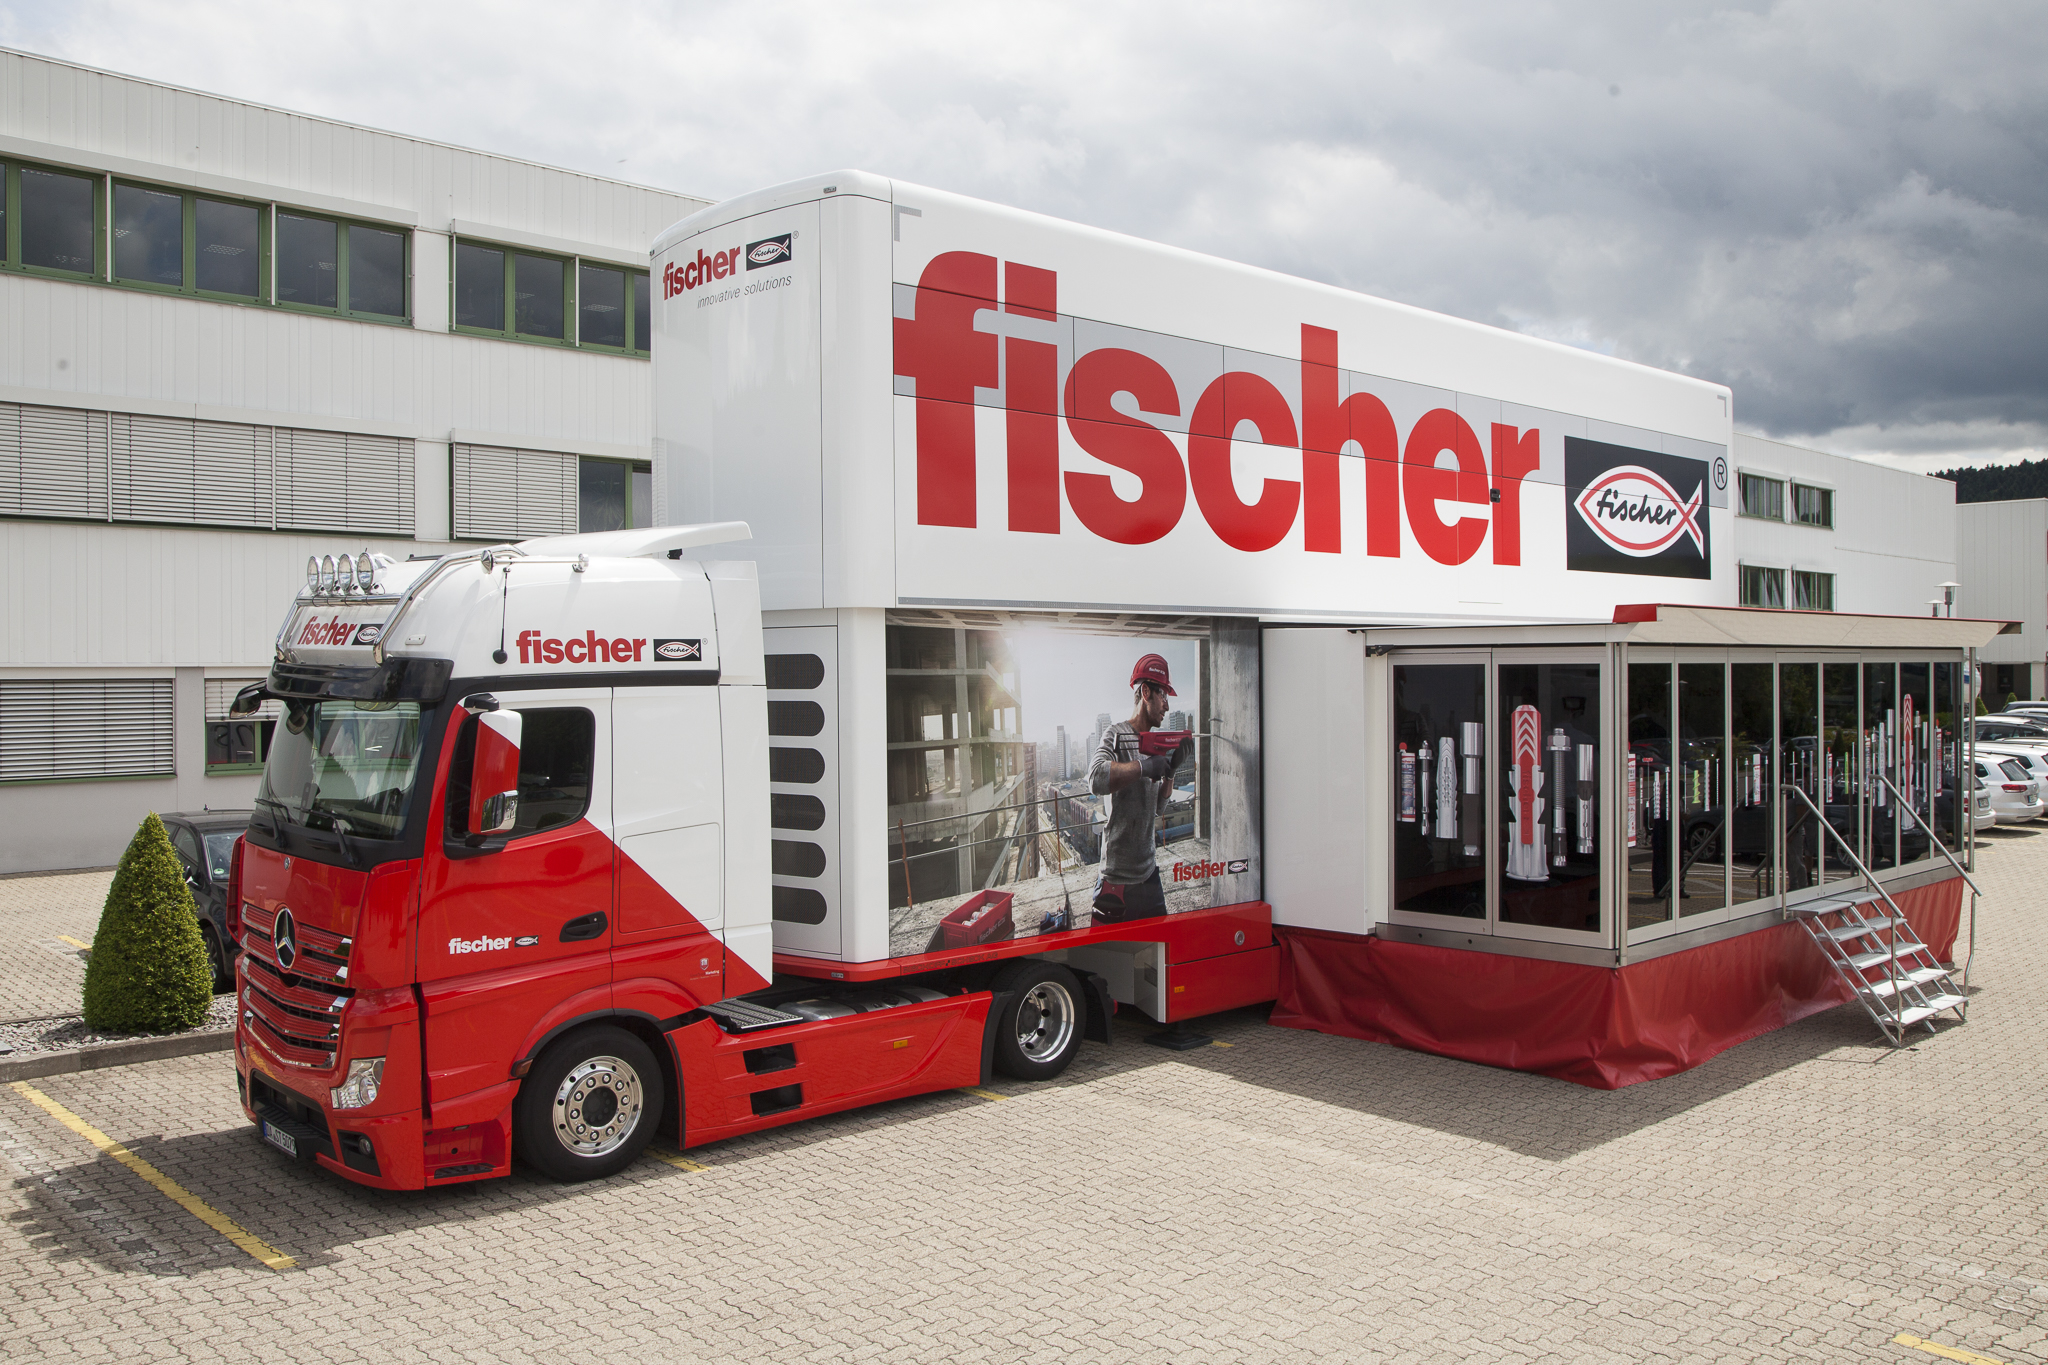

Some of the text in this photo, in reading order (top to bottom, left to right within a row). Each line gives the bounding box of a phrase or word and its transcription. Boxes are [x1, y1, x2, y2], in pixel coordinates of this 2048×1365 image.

[662, 245, 741, 301] fischer
[697, 275, 792, 309] innovative solutions
[893, 250, 1540, 566] fischer
[1596, 488, 1677, 525] fischer
[297, 615, 358, 646] fischer
[515, 629, 647, 664] fischer
[1172, 858, 1226, 882] fischer
[448, 935, 512, 955] fischer
[979, 925, 998, 942] fischer
